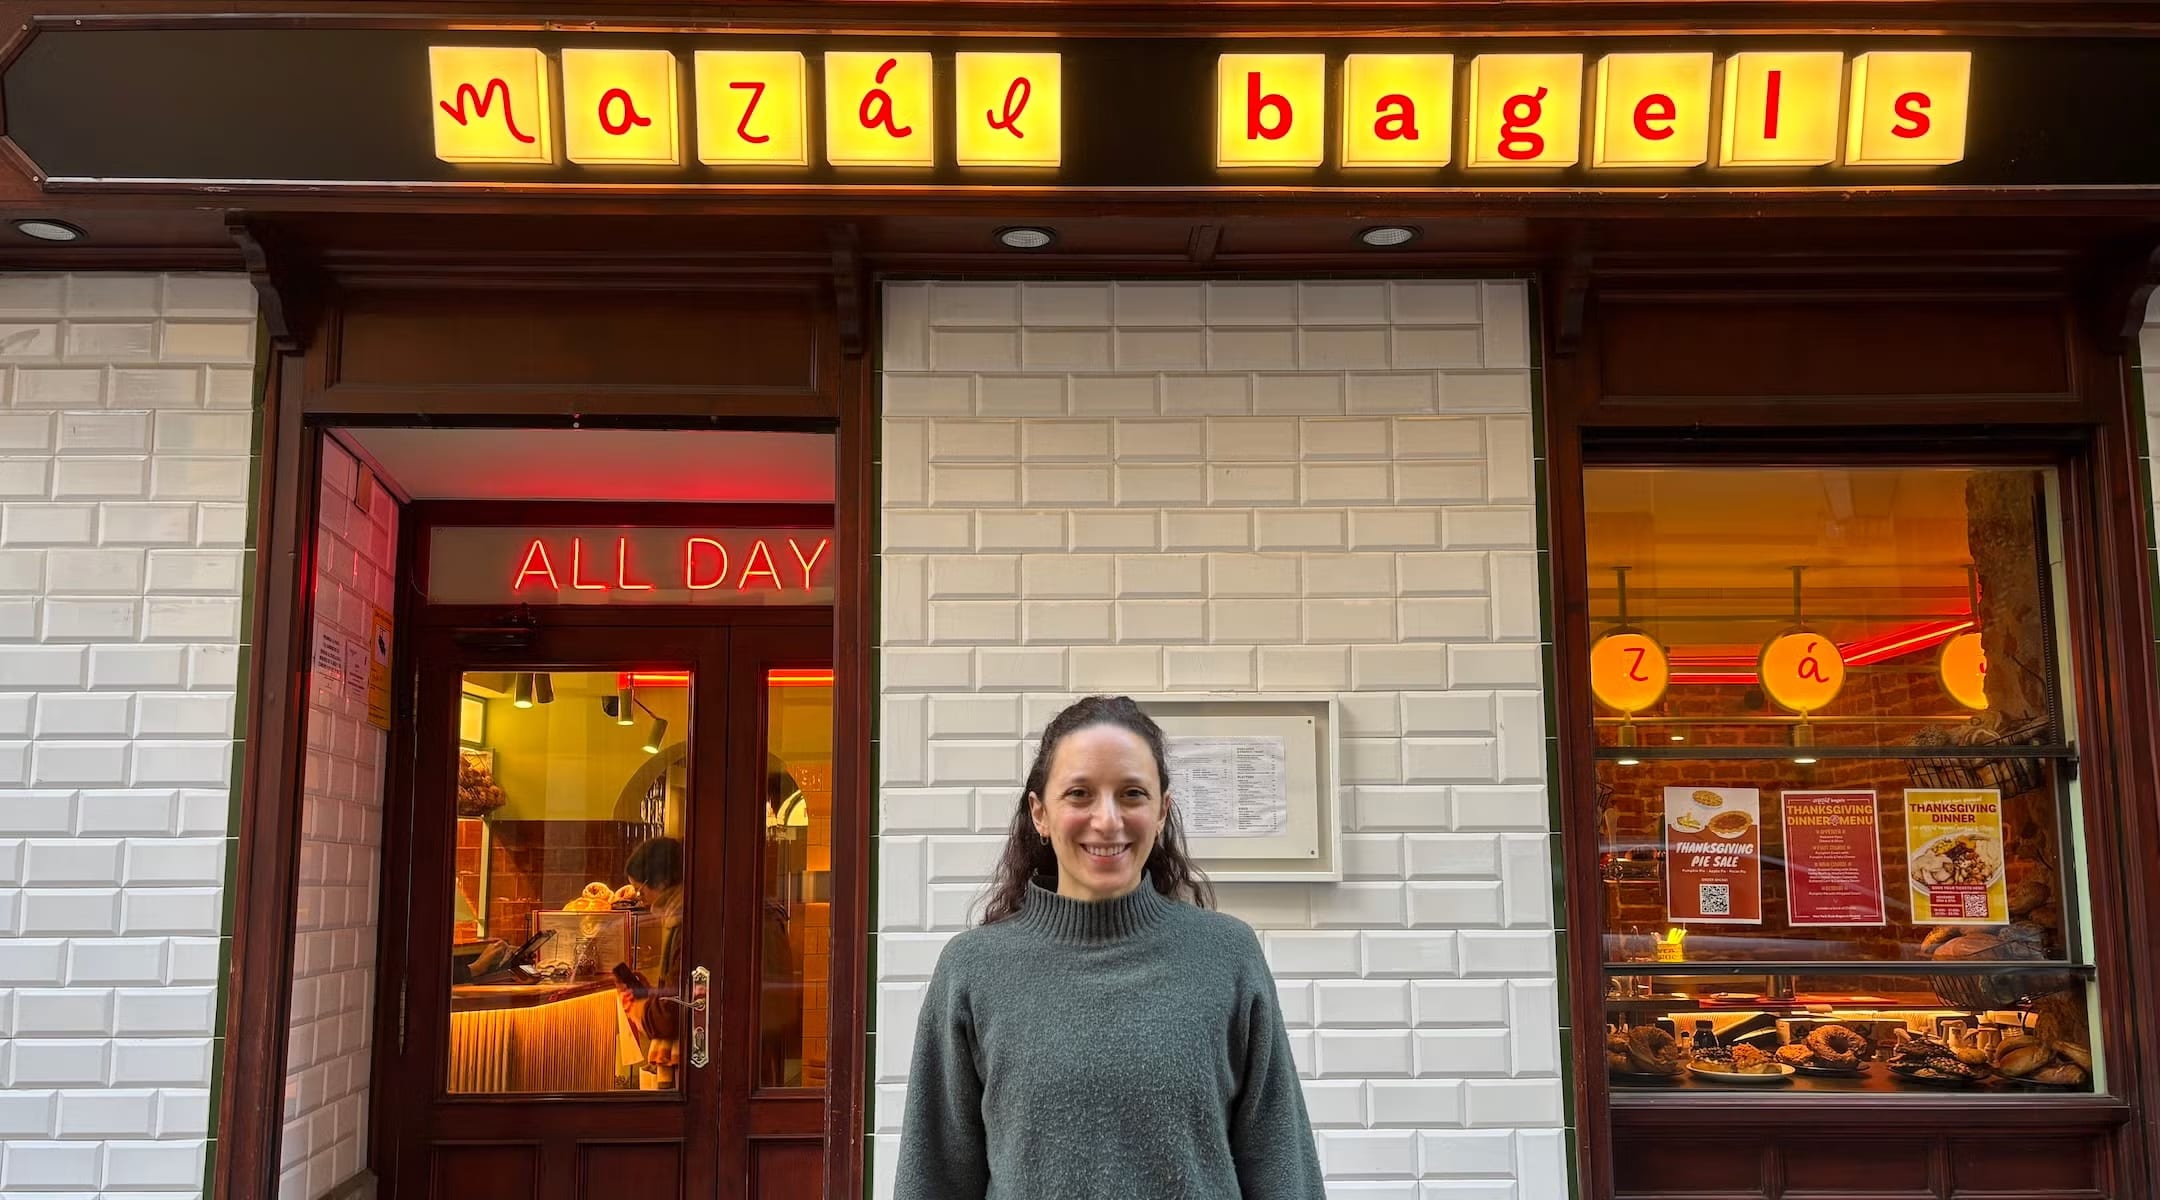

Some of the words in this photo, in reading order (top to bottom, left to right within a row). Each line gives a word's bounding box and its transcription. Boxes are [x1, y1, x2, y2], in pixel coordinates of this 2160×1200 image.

[1247, 71, 1931, 160] bagels
[513, 537, 655, 591] ALL
[686, 537, 829, 591] DAY
[1786, 805, 1873, 814] THANKSGIVING
[1910, 804, 1997, 813] THANKSGIVING
[1787, 816, 1831, 825] DINNER
[1840, 815, 1873, 825] MENU
[1932, 814, 1976, 823] DINNER
[1676, 842, 1754, 855] THANKSGIVING
[1691, 855, 1711, 867] PIE
[1713, 856, 1739, 868] SALE
